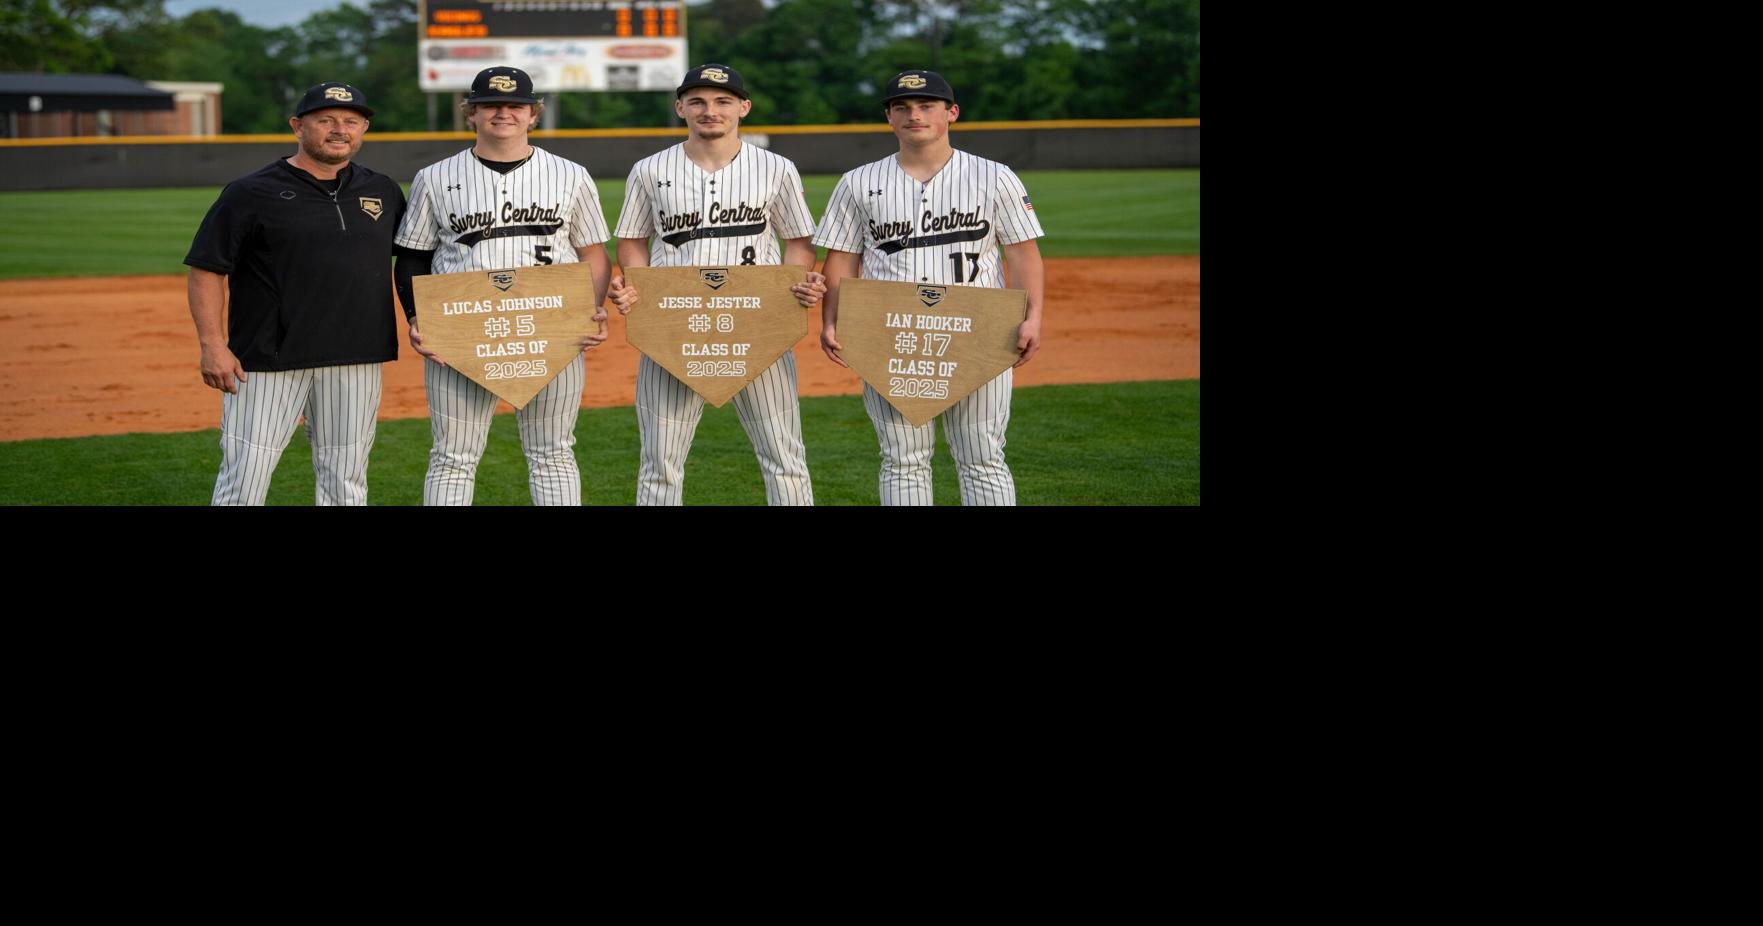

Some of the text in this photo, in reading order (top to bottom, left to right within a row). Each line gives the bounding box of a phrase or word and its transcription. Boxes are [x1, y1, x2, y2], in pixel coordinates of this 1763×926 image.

[449, 201, 564, 238] Surry Central
[659, 201, 767, 238] Surry Central
[868, 205, 981, 246] Surry Central
[533, 244, 553, 266] 5
[949, 252, 980, 283] 17
[442, 295, 563, 315] LUCAS JOHNSON
[658, 296, 761, 309] JESSE JESTER
[885, 312, 972, 333] IAN HOOKER
[475, 340, 548, 357] CLASS OF
[682, 343, 751, 356] CLASS OF
[484, 359, 548, 380] 2025
[687, 361, 746, 377] 2025
[888, 358, 958, 378] CLASS OF
[889, 376, 949, 400] 2025
